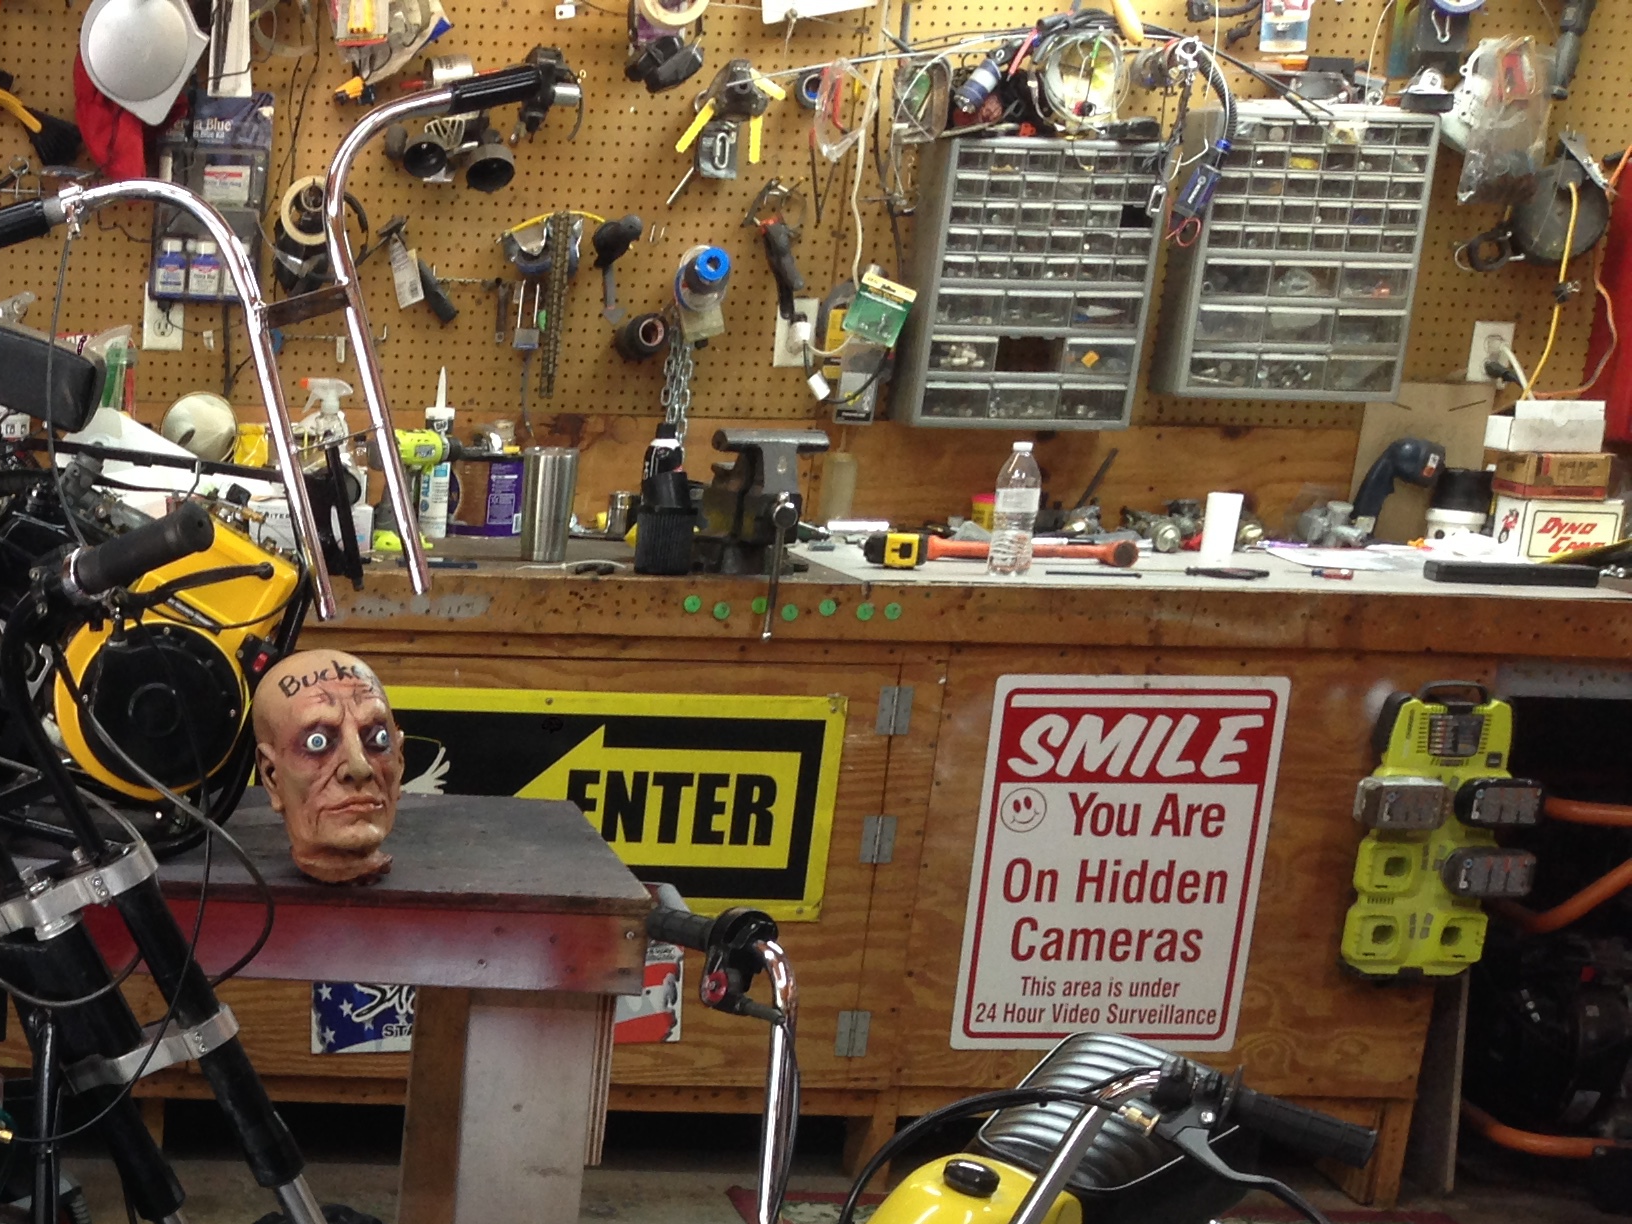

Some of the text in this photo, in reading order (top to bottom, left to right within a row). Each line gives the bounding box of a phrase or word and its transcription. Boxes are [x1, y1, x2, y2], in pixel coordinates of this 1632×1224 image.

[206, 117, 232, 132] Blue
[1007, 713, 1265, 778] SMILE
[567, 768, 778, 847] ENTER
[1068, 792, 1226, 837] You Are
[1002, 857, 1228, 904] On Hidden
[1010, 916, 1204, 963] Cameras
[1020, 976, 1180, 998] This area is under
[975, 1003, 1217, 1026] 24 Hour Video Surveillance
